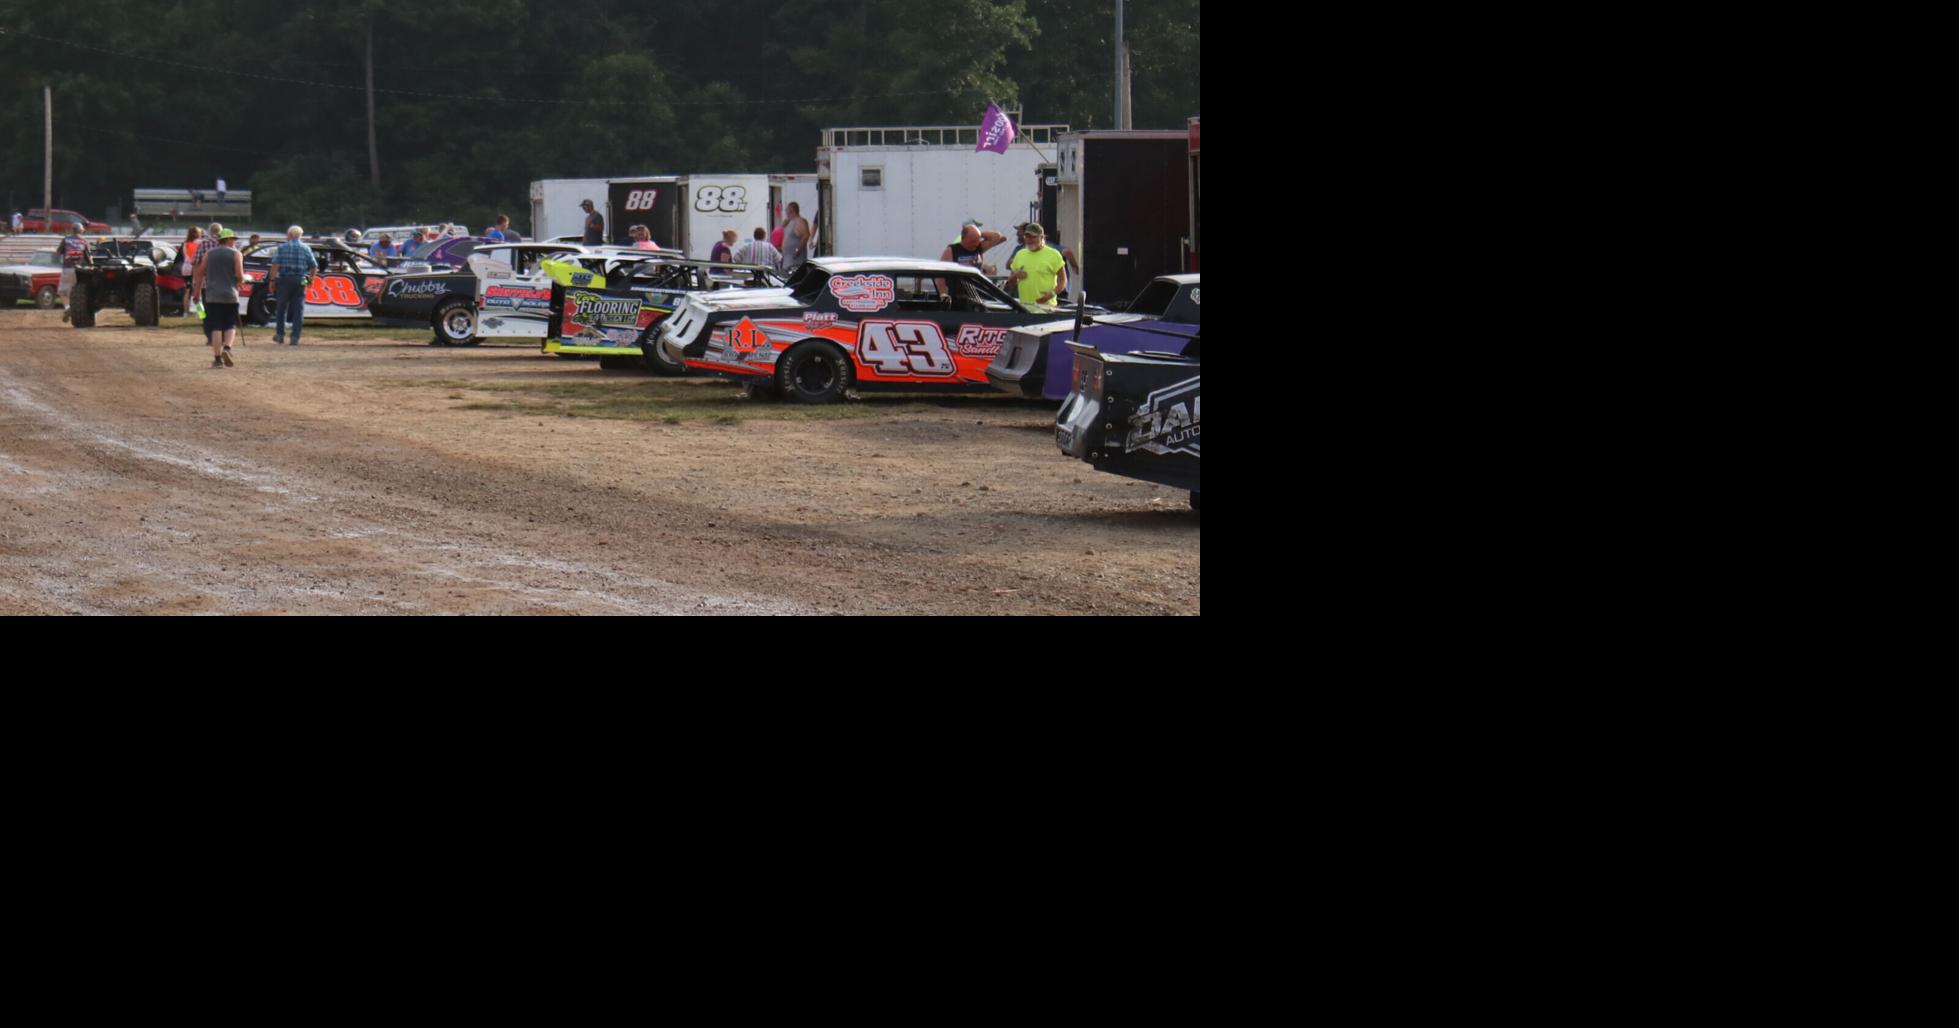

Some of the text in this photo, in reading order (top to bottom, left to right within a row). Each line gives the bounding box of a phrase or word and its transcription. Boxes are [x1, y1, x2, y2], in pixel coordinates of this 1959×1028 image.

[625, 190, 657, 211] 88
[388, 278, 452, 298] Chubby
[832, 279, 890, 288] Creekside
[872, 289, 890, 298] Inn
[580, 301, 637, 314] FLOORING
[860, 321, 955, 375] 43
[1166, 425, 1200, 446] AUTO
